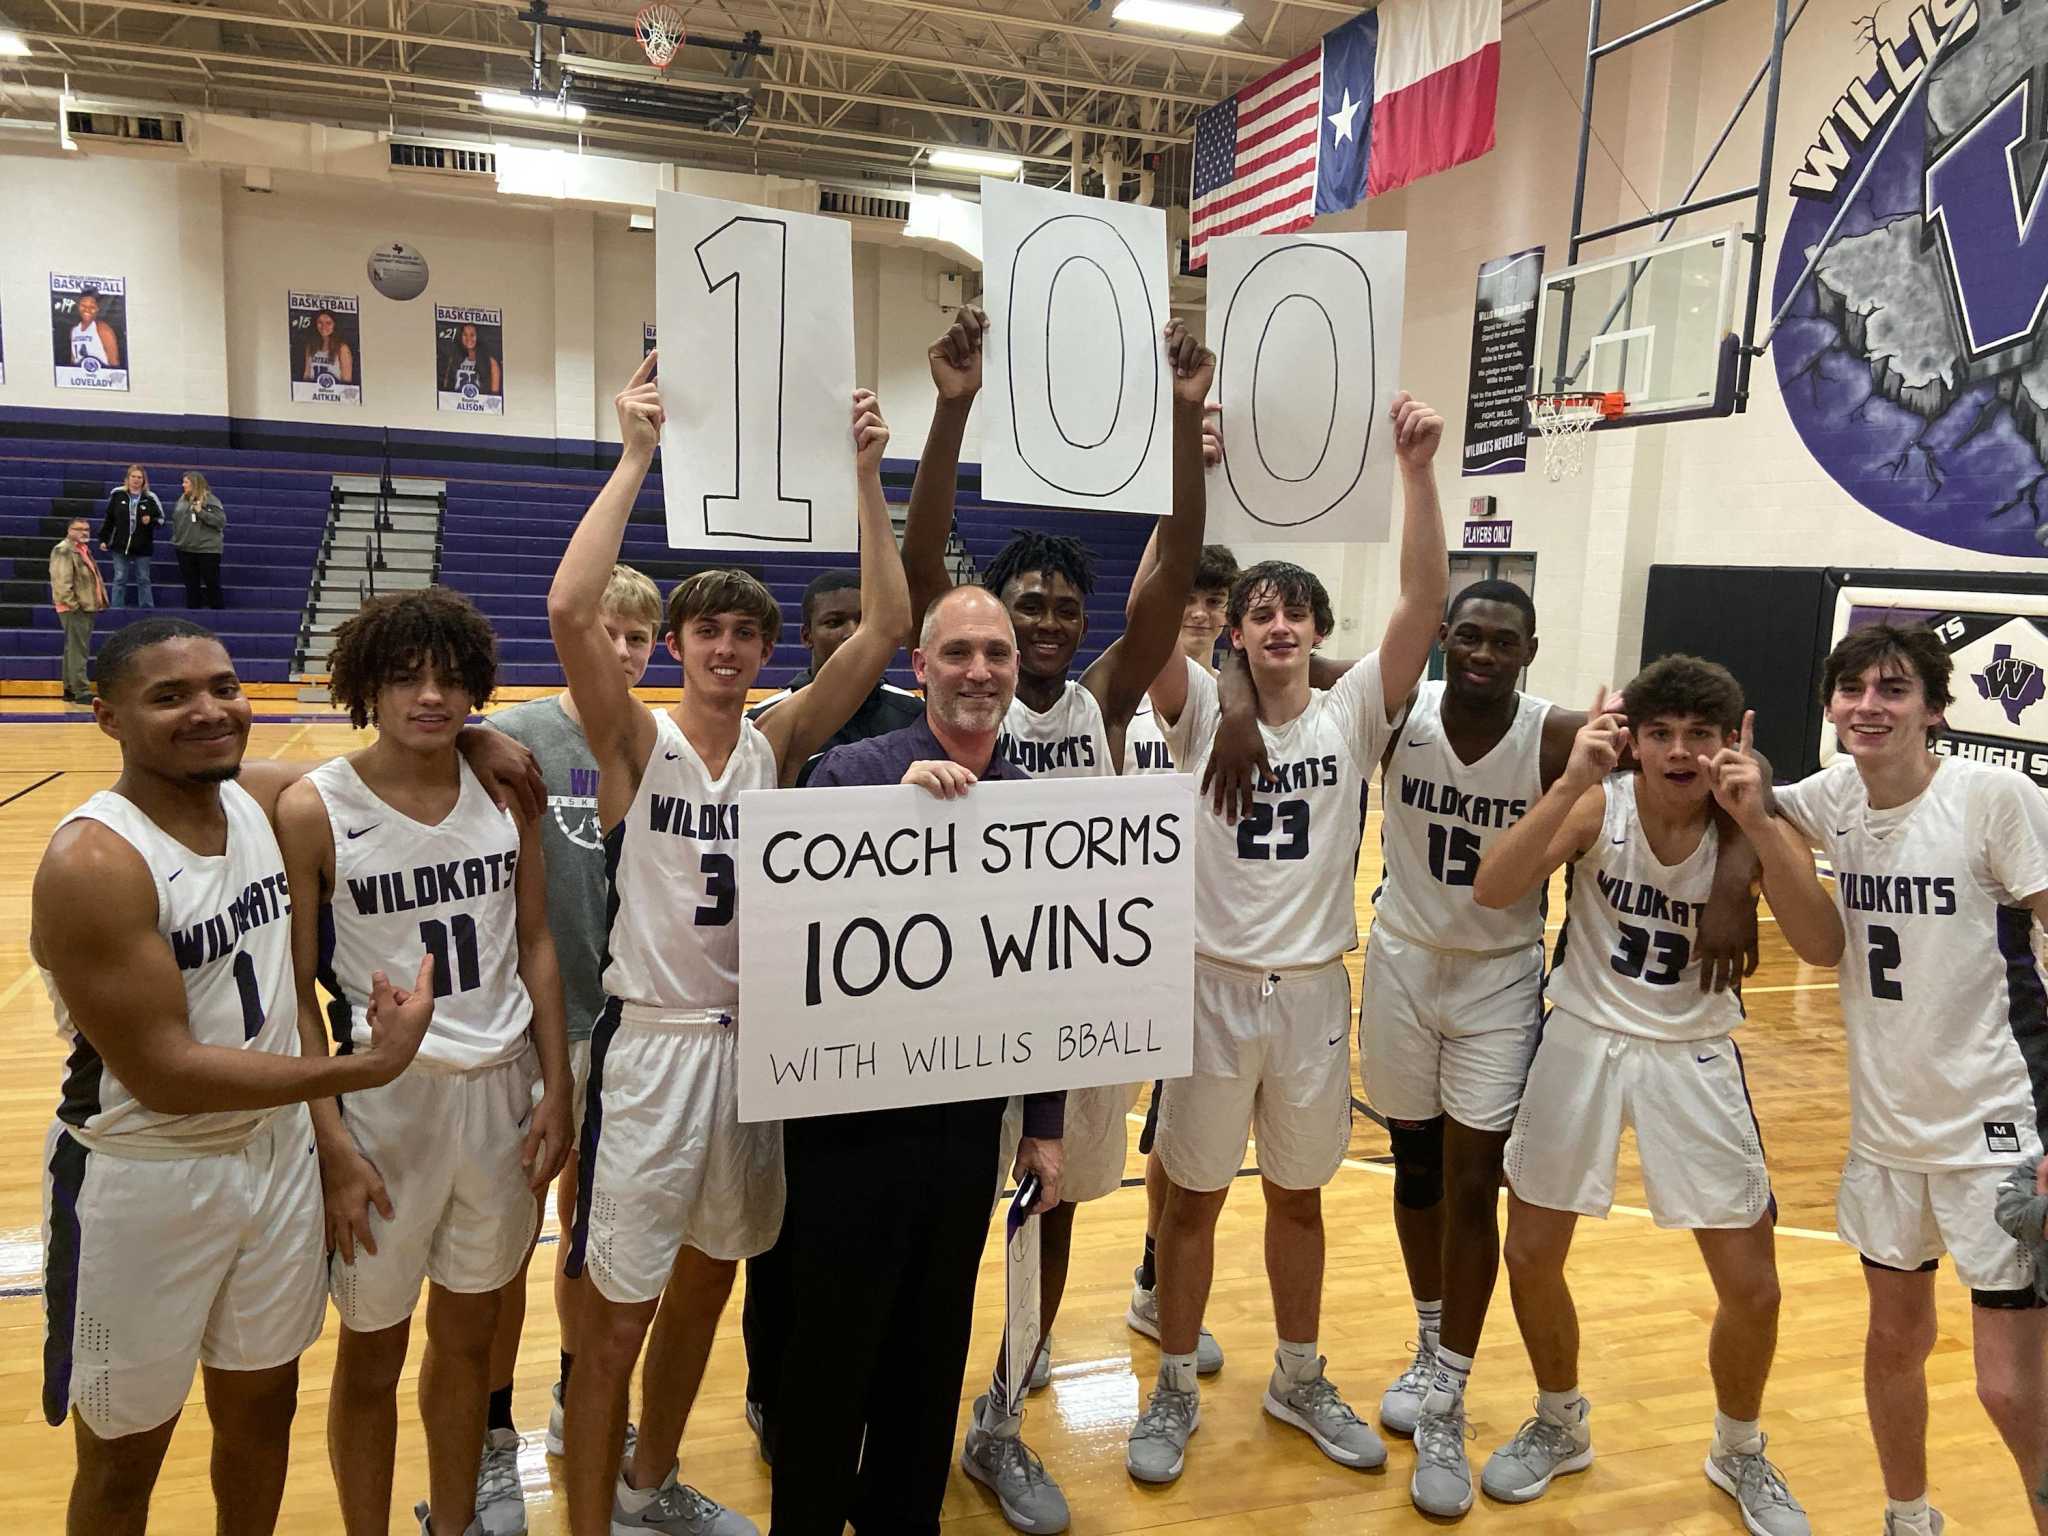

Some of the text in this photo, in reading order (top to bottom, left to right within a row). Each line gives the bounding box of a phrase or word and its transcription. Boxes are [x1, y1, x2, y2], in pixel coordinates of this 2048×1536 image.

[291, 296, 356, 311] BASKETBALL
[438, 309, 499, 323] BASKETBALL
[71, 378, 113, 388] LOVELADY
[456, 402, 485, 412] ALISON
[695, 214, 1375, 543] 1 0 0
[1464, 439, 1494, 458] WILDKATS
[1494, 434, 1513, 452] NEVER
[1464, 525, 1512, 545] PLAYERS ONLY
[1957, 742, 2026, 772] HIGH
[1237, 799, 1310, 861] 23
[1401, 774, 1526, 829] WILDKATS
[762, 812, 1182, 884] COACH STORMS
[1427, 821, 1482, 887] 15
[346, 849, 518, 916] WILDKATS
[694, 853, 736, 927] 3
[1839, 871, 1957, 916] WILDKATS
[170, 871, 293, 971] WILDKATS
[804, 896, 1154, 1007] 100 WINS
[1610, 919, 1691, 986] 33
[418, 911, 481, 999] 11
[1867, 924, 1904, 1002] 2
[232, 949, 266, 1042] 1
[770, 1018, 1162, 1085] WITH WILLIS BBALL
[1992, 1125, 2007, 1135] M
